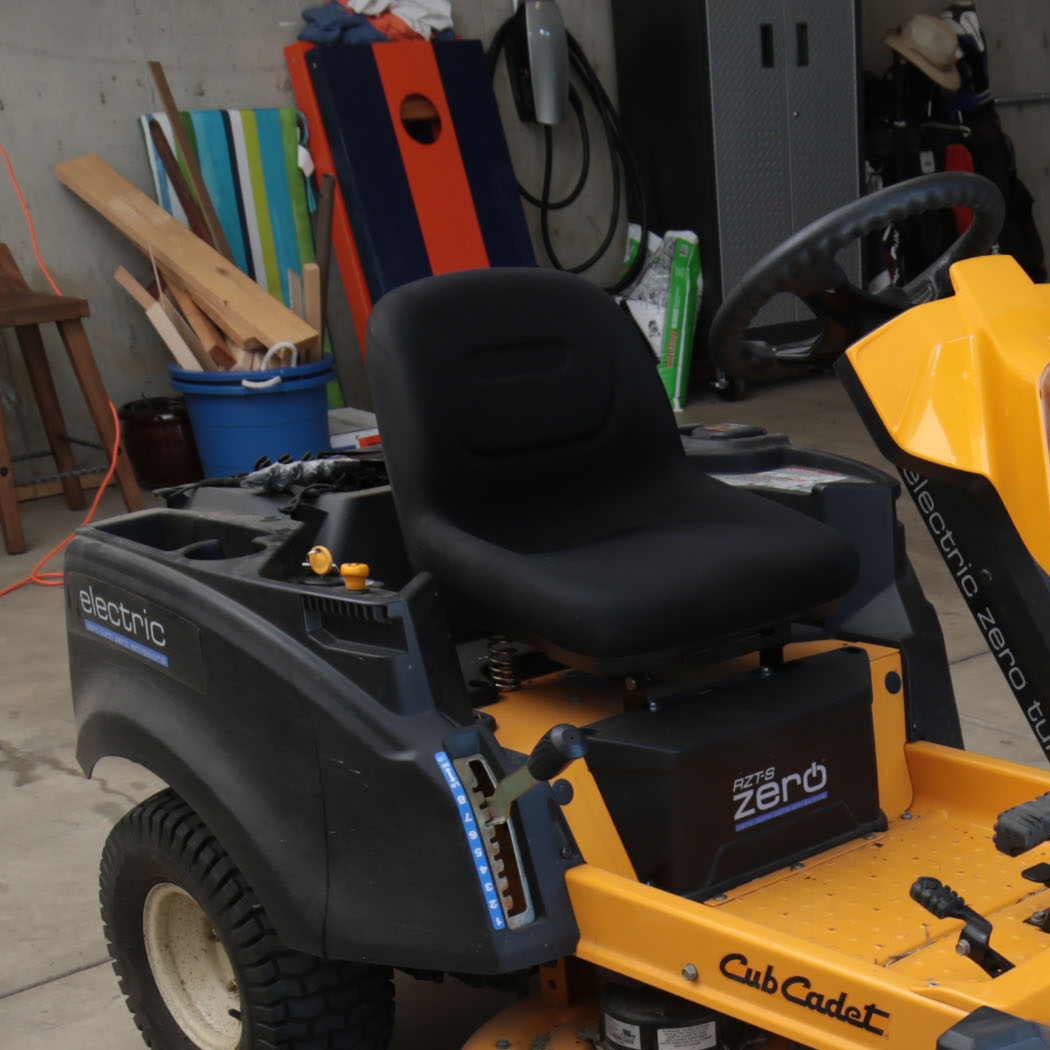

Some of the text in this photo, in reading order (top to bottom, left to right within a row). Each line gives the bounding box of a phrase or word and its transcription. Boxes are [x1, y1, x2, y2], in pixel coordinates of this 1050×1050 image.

[903, 469, 978, 598] electric
[977, 607, 1026, 691] zero
[80, 585, 166, 647] electric
[733, 767, 776, 792] RZT-S
[732, 762, 827, 820] zero
[457, 794, 466, 805] 8
[465, 813, 473, 822] 7
[469, 830, 478, 840] 6
[475, 848, 483, 858] 5
[480, 866, 488, 875] 4
[485, 882, 493, 892] 3
[489, 900, 498, 909] 2
[495, 917, 502, 926] 1
[719, 953, 890, 1036] Cub Cadet
